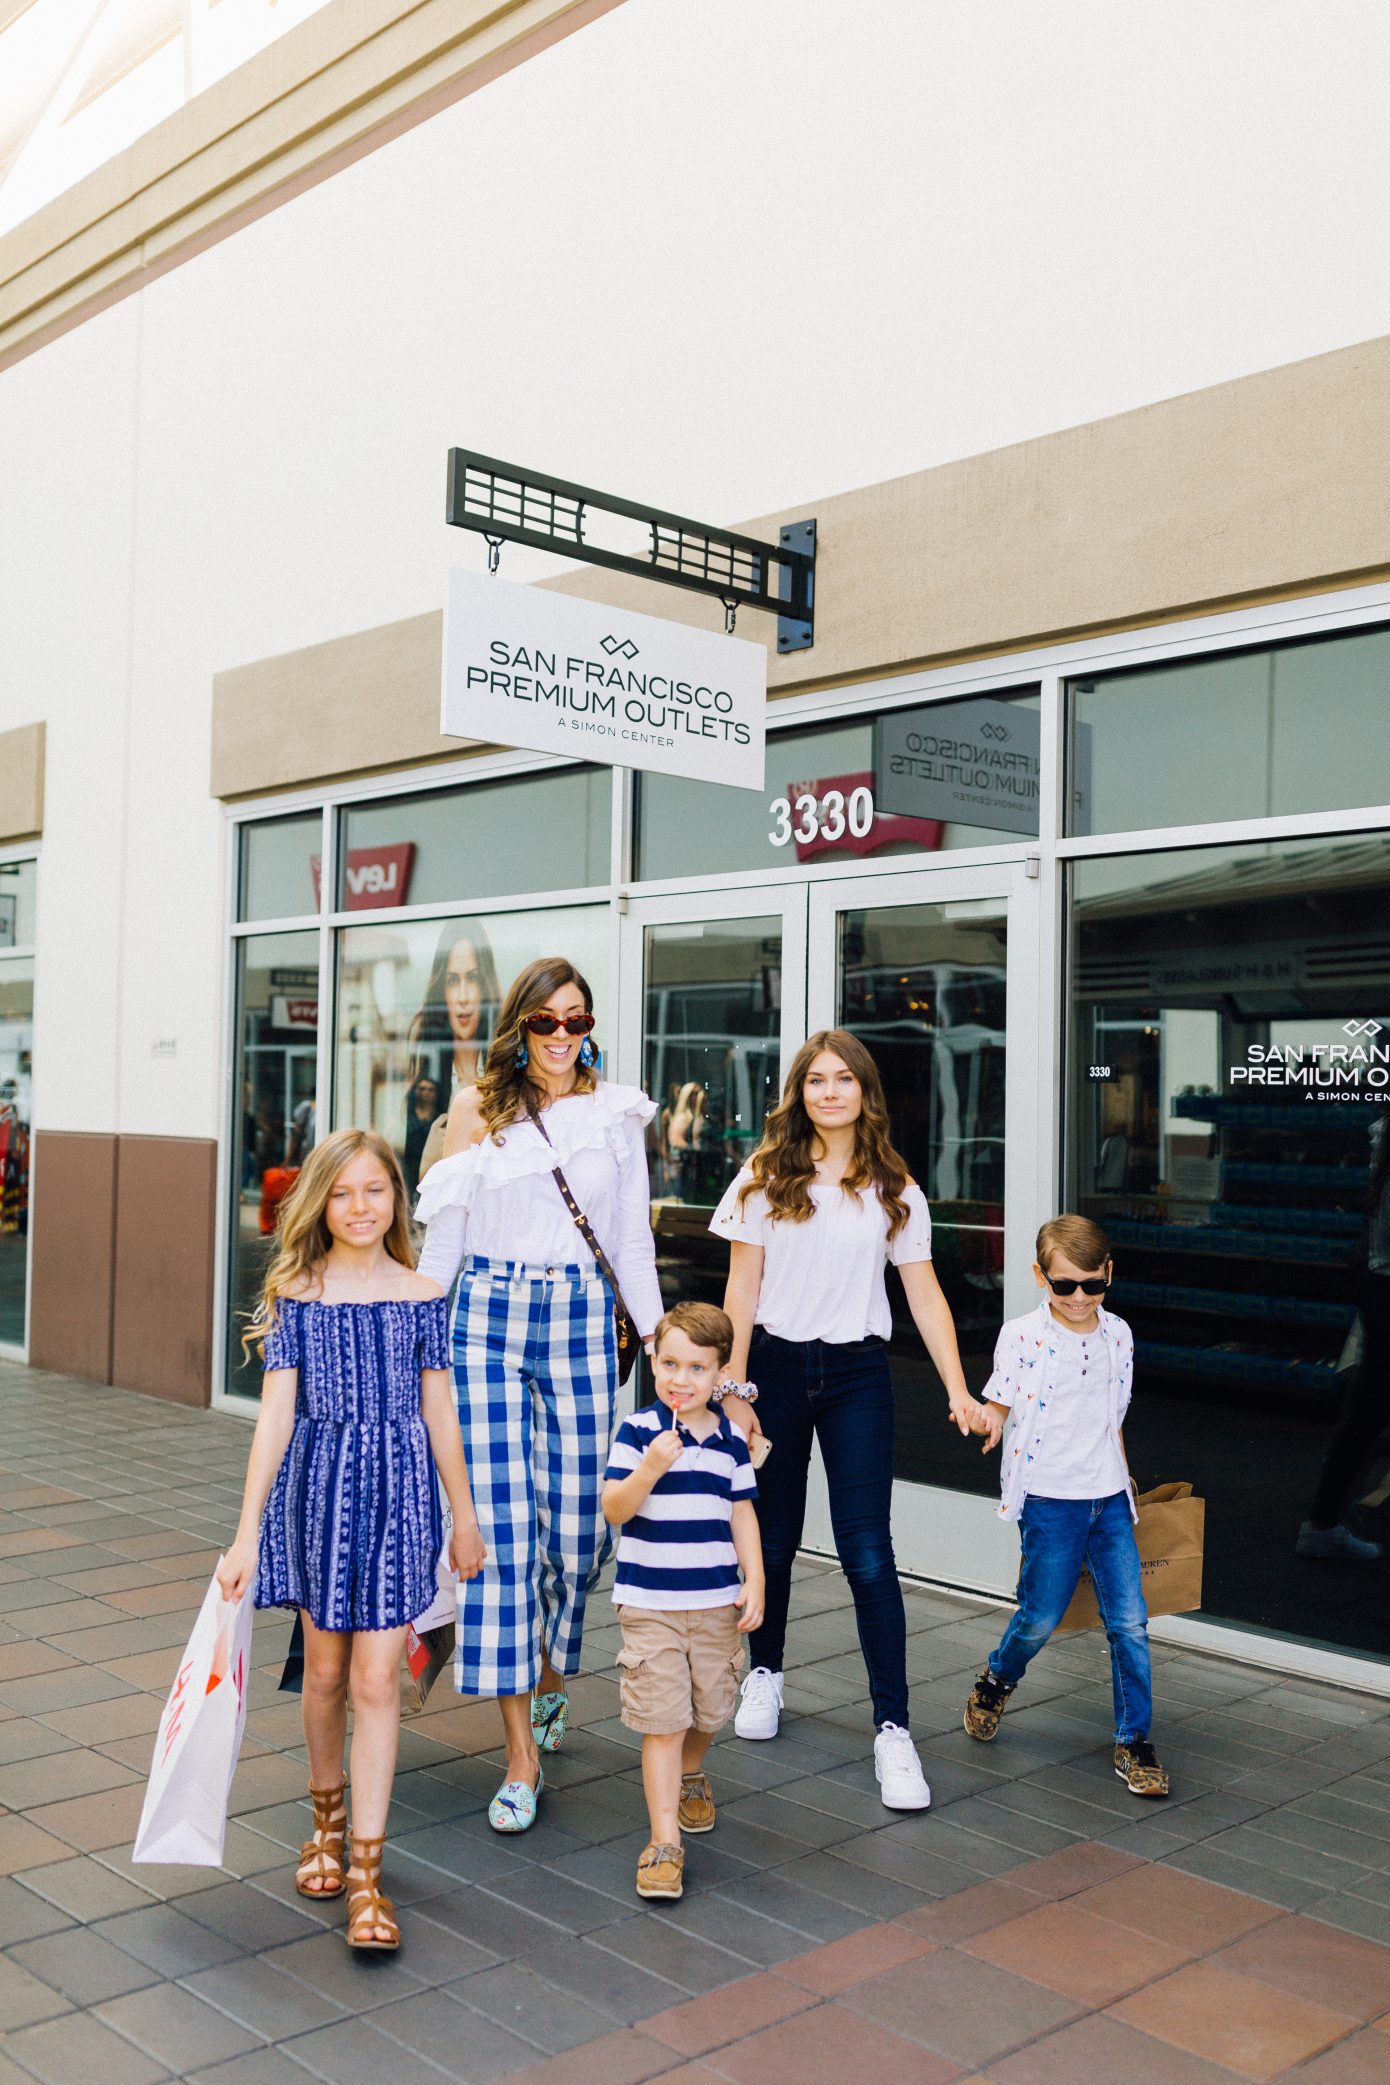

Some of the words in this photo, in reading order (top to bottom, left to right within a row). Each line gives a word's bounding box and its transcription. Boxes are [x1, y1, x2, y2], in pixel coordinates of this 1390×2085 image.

[489, 640, 556, 676] SAN
[566, 657, 733, 713] FRANCISCO
[467, 665, 616, 718] PREMIUM
[624, 700, 751, 745] OUTLETS
[557, 717, 567, 727] A
[571, 719, 616, 737] SIMON
[621, 729, 675, 748] CENTER
[768, 786, 874, 847] 3330
[1247, 1044, 1304, 1063] SAN
[1089, 1066, 1110, 1078] 3330
[1230, 1066, 1359, 1086] PREMIUM
[1305, 1092, 1314, 1100] A
[1318, 1092, 1360, 1101] SIMON
